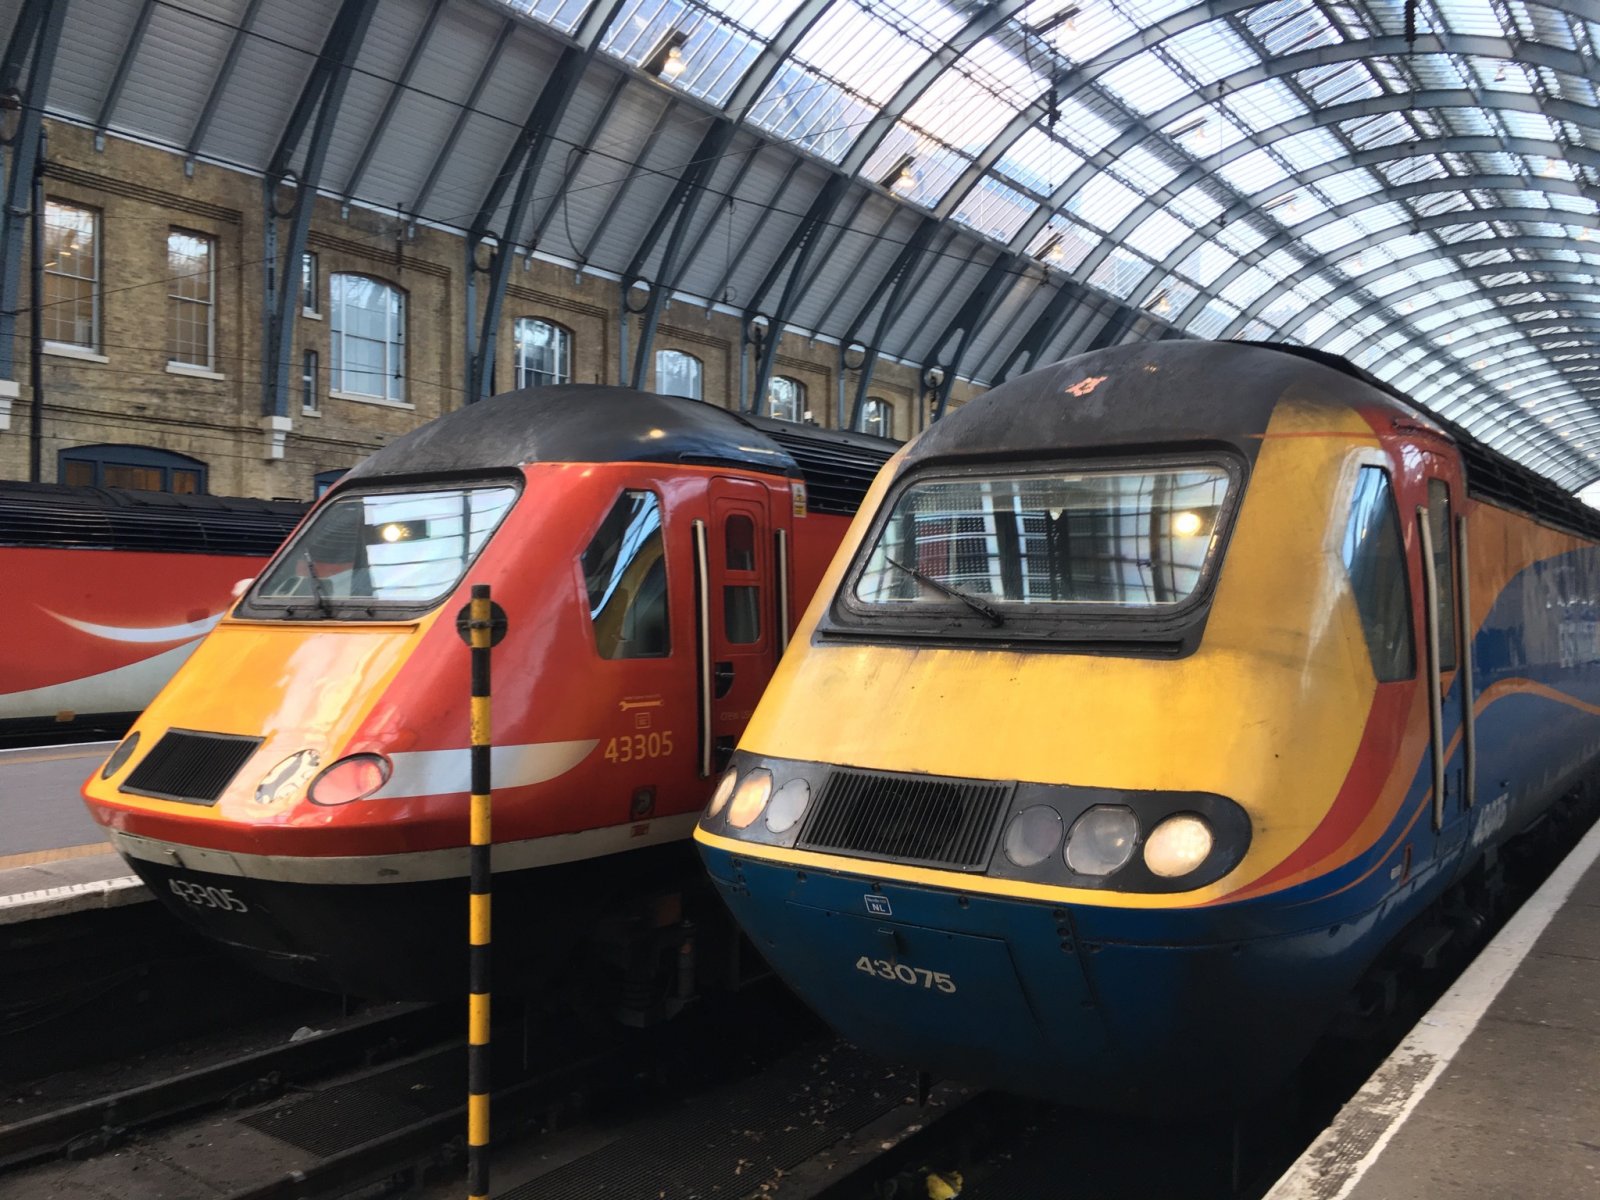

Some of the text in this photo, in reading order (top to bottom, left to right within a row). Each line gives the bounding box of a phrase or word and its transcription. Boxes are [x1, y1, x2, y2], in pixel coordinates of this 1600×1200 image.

[604, 731, 673, 763] 43305
[168, 878, 249, 913] 43305
[871, 903, 886, 913] NL
[856, 956, 957, 994] 43075
